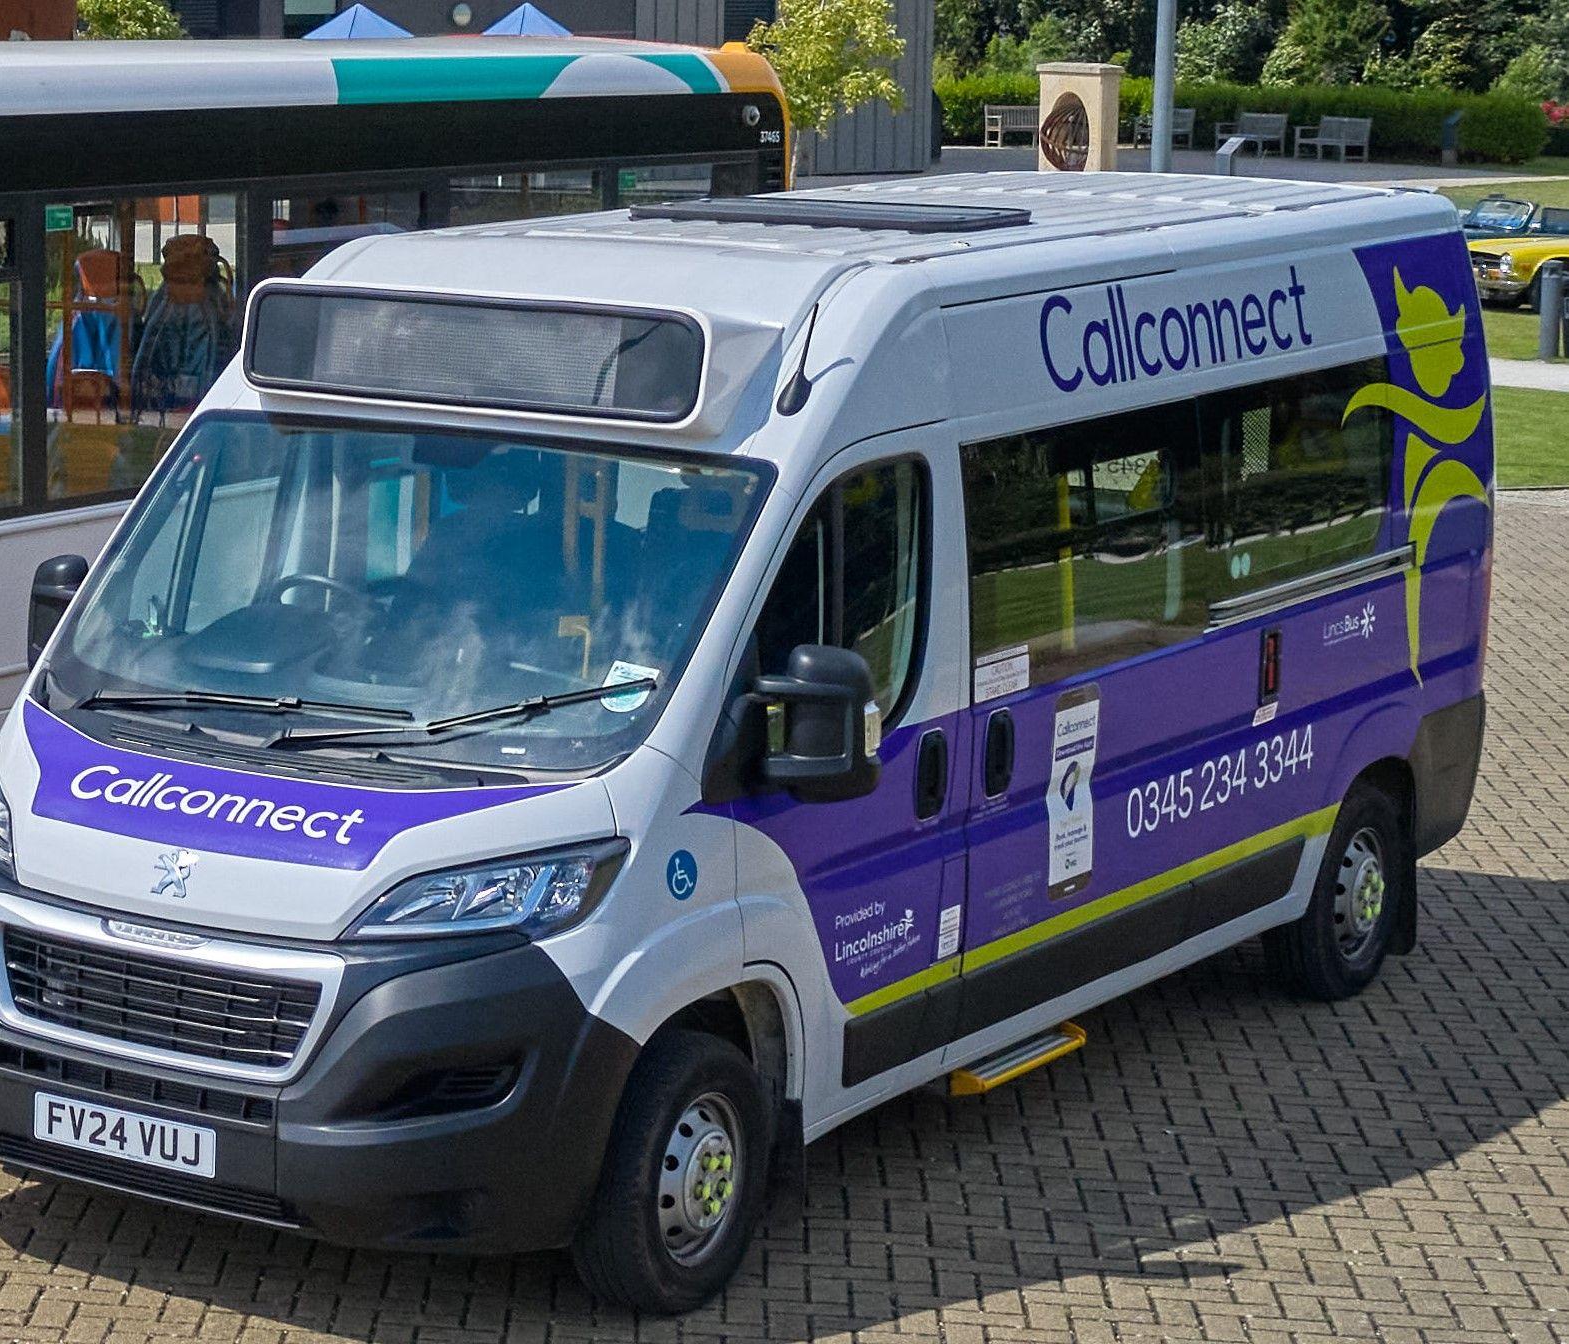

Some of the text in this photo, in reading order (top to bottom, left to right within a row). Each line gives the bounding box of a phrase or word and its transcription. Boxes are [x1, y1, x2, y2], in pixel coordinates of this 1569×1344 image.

[1039, 265, 1312, 393] Callconnect
[70, 765, 365, 845] Callconnect
[1127, 724, 1313, 838] 0345 234 3344
[835, 901, 886, 929] Provided by
[835, 922, 905, 962] Lincolnshire
[47, 1101, 200, 1166] FV24 VUJ
